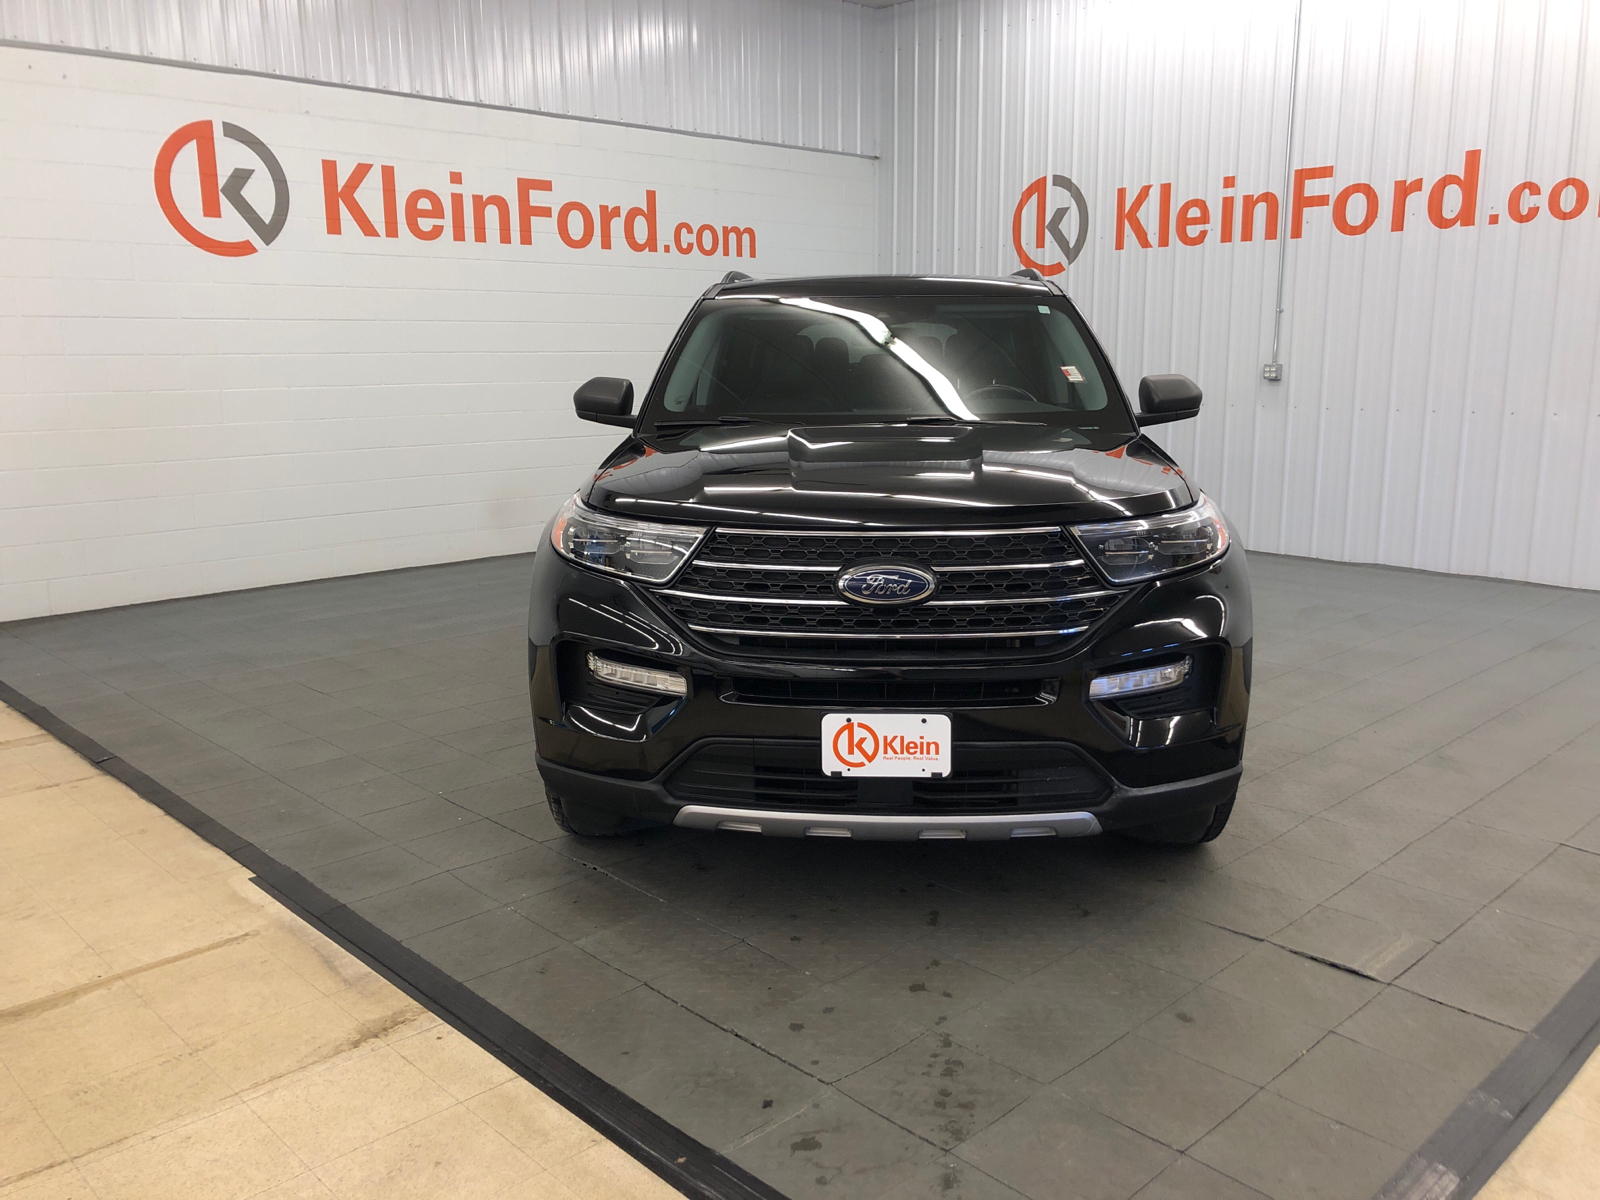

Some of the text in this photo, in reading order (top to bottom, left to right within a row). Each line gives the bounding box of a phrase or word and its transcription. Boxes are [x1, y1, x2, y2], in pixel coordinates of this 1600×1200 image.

[321, 158, 757, 259] KleinFord.com
[1114, 148, 1600, 251] KleinFord.co
[855, 573, 918, 595] Ford
[882, 735, 940, 755] Klein
